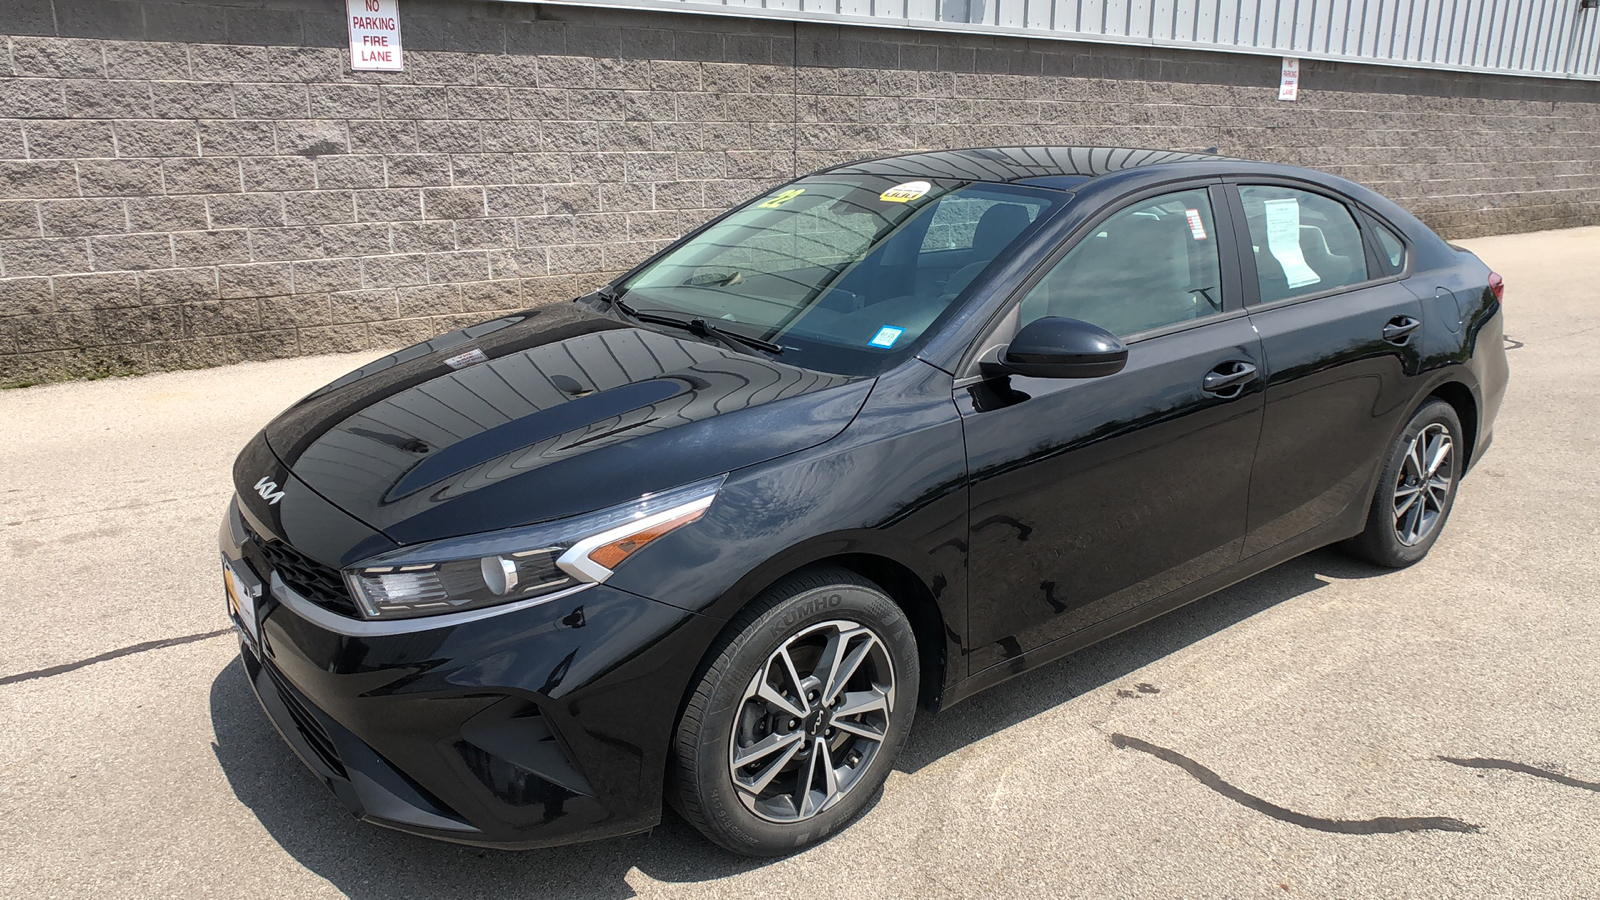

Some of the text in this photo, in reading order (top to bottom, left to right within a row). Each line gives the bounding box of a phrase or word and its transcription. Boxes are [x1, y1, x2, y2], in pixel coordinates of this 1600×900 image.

[365, 0, 380, 12] NO
[353, 16, 396, 31] PARKING
[363, 35, 388, 47] FIRE
[361, 50, 392, 62] LANE
[769, 593, 842, 638] KUMHO
